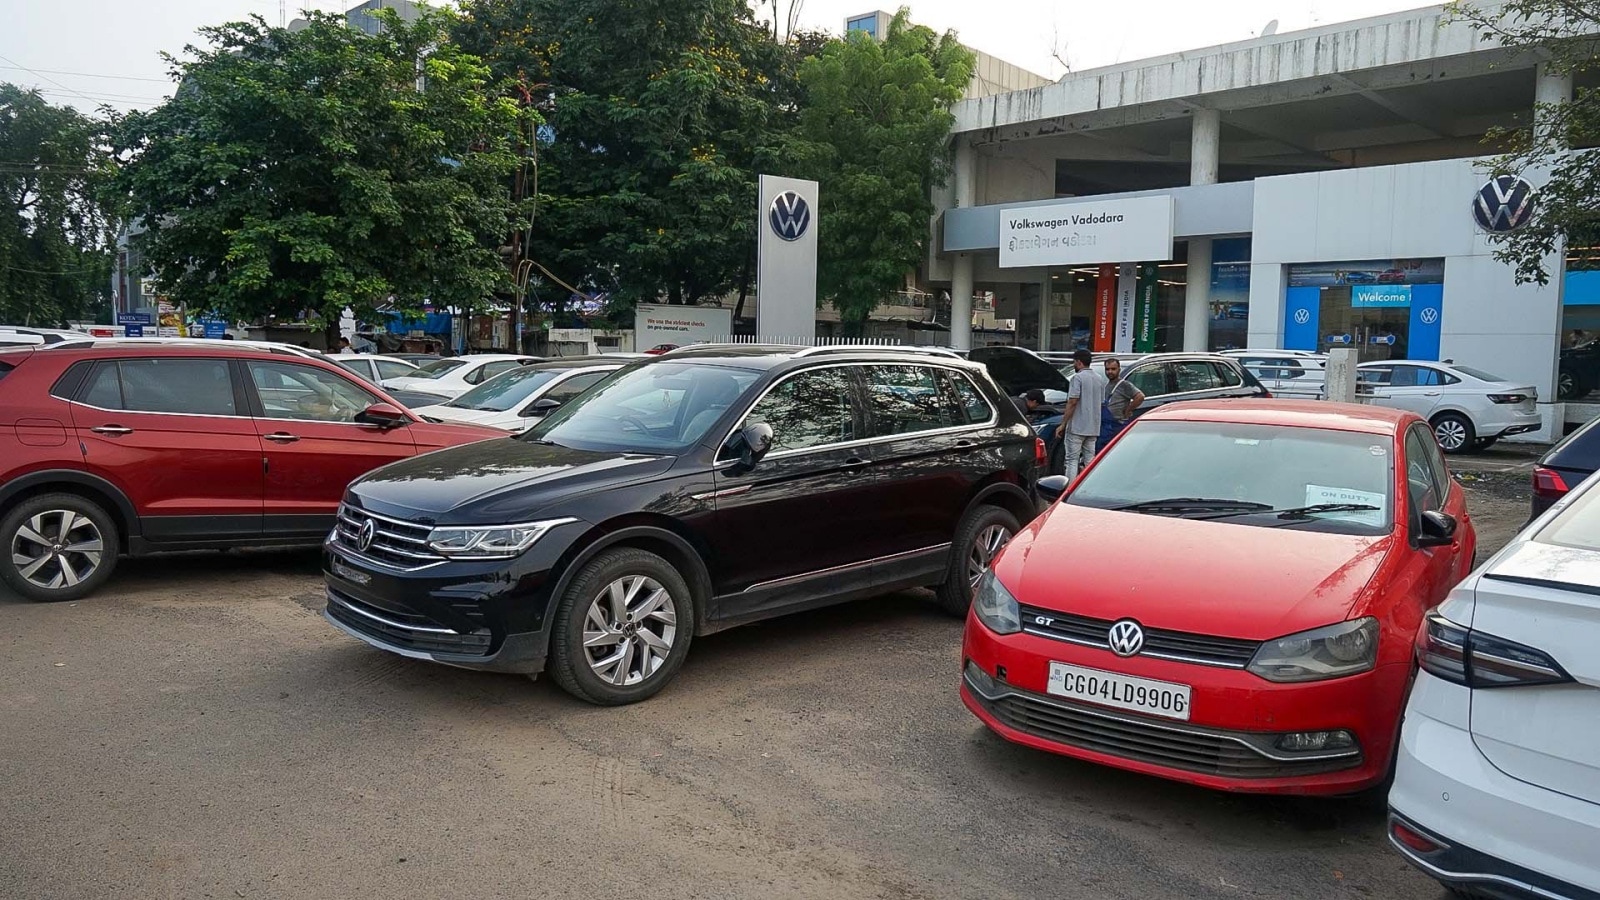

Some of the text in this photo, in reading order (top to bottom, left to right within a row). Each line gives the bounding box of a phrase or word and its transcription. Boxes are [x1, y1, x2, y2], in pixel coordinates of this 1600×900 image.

[1010, 212, 1123, 230] Volkswagen Vadodara
[1358, 291, 1406, 302] Welcome
[1340, 493, 1370, 502] DUTY
[1035, 616, 1055, 626] GT
[1064, 672, 1184, 713] CG04LD9906
